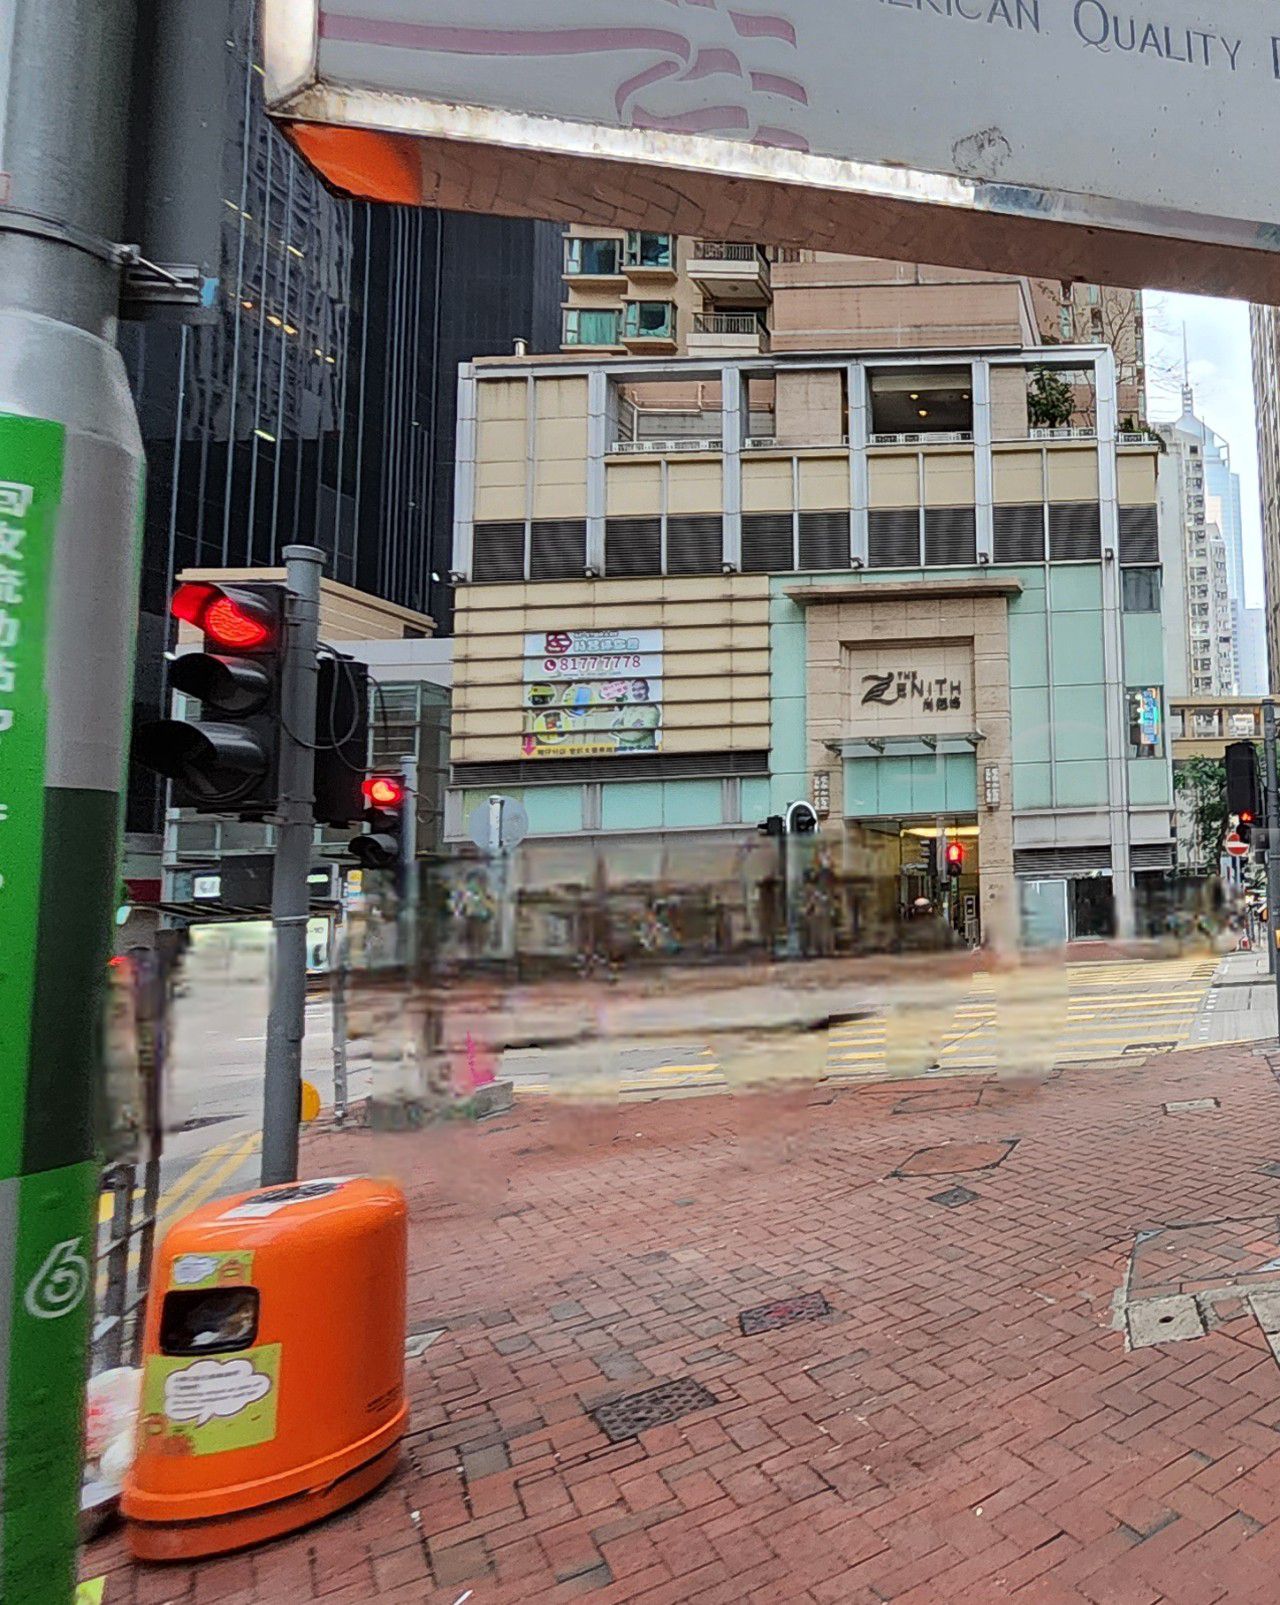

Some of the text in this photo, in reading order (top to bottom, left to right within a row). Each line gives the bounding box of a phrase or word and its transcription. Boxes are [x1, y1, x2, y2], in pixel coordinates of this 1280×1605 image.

[879, 0, 1041, 33] ICAN
[1073, 0, 1242, 70] QUALITY
[559, 655, 641, 671] 8177 7778
[897, 670, 918, 680] THE
[861, 671, 962, 706] ZENITH
